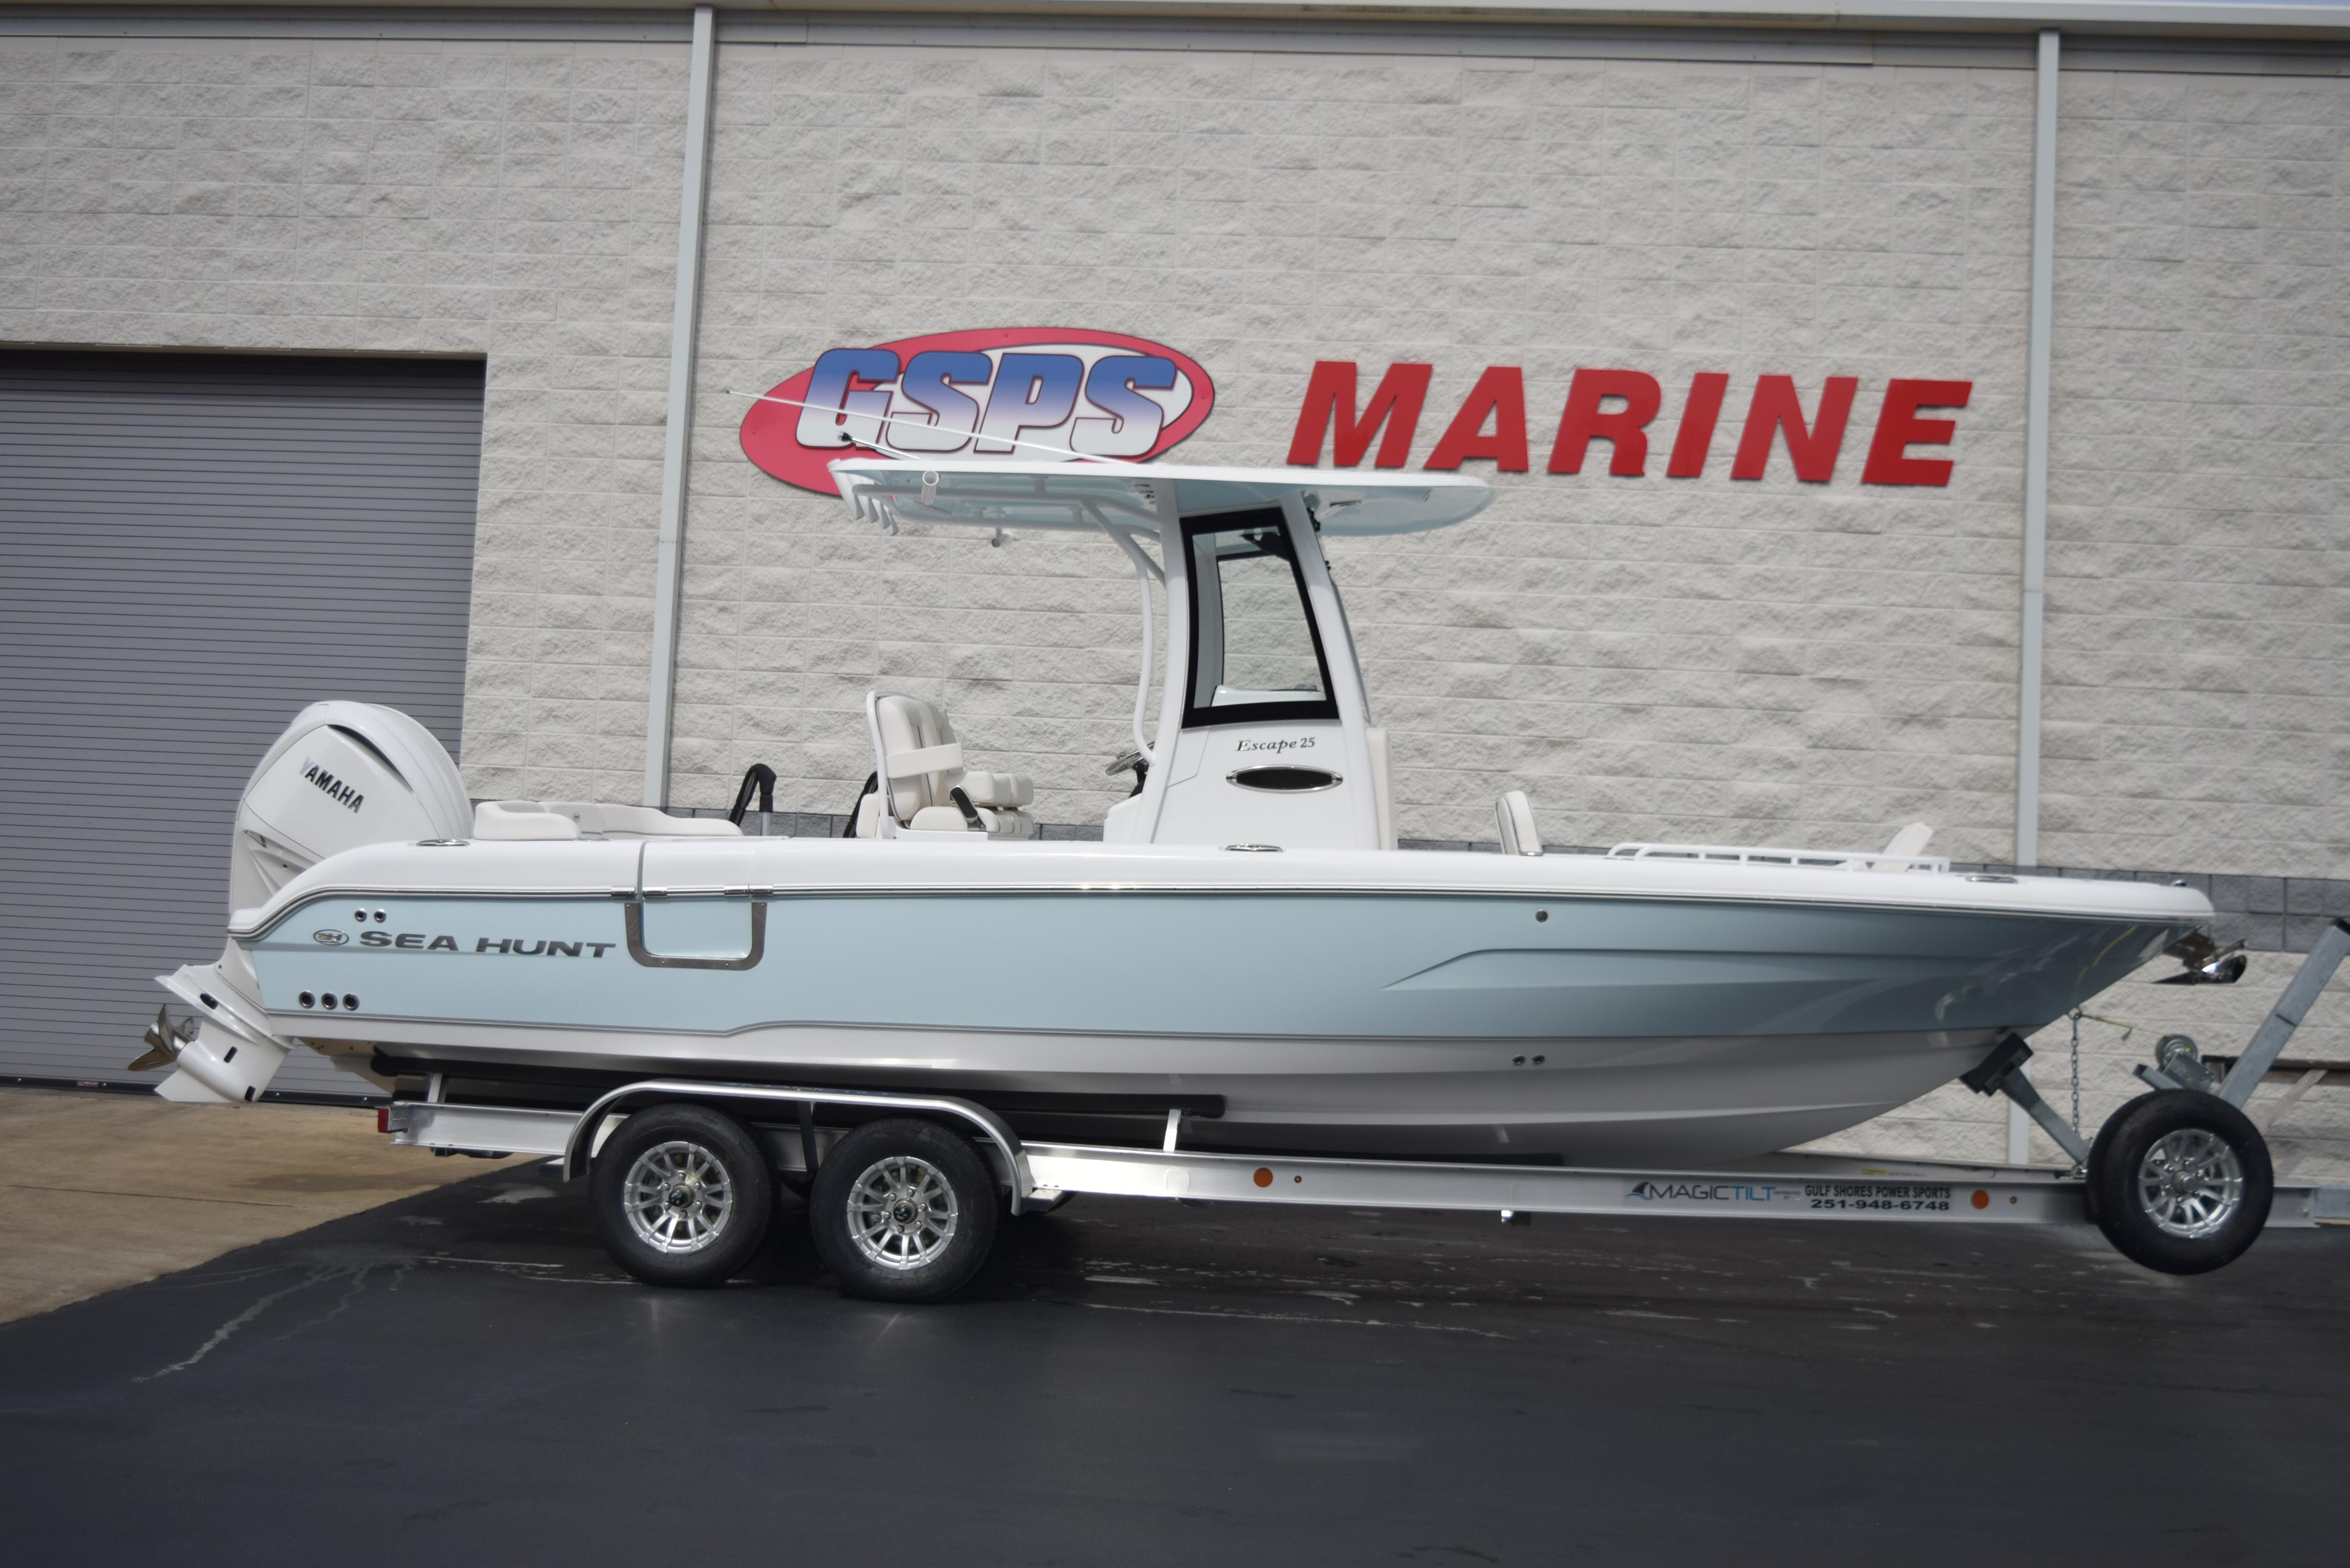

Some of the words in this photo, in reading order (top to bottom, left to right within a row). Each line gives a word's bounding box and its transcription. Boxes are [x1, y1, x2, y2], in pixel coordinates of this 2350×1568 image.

[795, 347, 1179, 457] GSPS
[1286, 360, 1973, 486] MARINE
[1235, 739, 1297, 754] Escape
[1300, 737, 1316, 748] 25
[299, 756, 365, 814] YAMAHA
[360, 931, 459, 951] SEA
[476, 937, 617, 958] HUNT
[1649, 1184, 1776, 1201] MAGICTILT
[1805, 1184, 1830, 1197] GULF
[1833, 1185, 1872, 1197] SHORES
[1875, 1186, 1910, 1198] POWER
[1913, 1187, 1950, 1199] SPORTS
[1810, 1199, 1950, 1211] 251-948-6748
